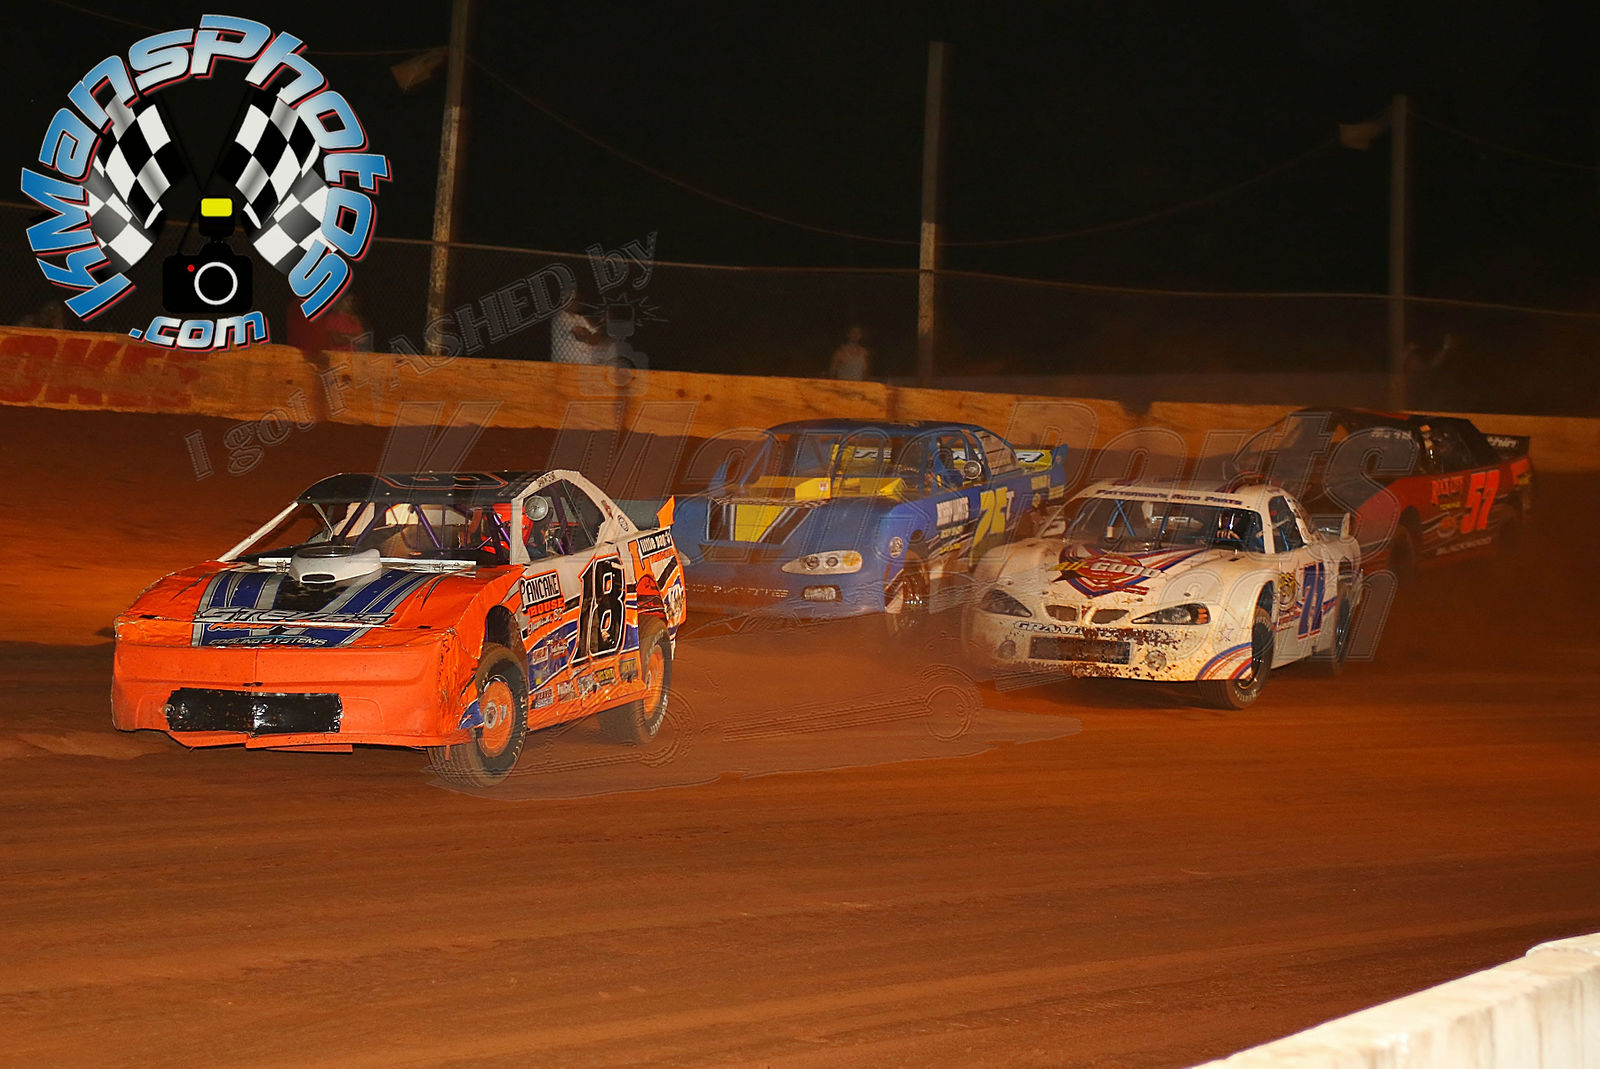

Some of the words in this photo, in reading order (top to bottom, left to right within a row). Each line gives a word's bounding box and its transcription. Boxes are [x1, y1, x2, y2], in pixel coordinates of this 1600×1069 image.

[1460, 469, 1500, 534] 57
[519, 573, 559, 609] PANCAKE
[529, 598, 564, 616] HOUSE
[571, 554, 626, 664] 18
